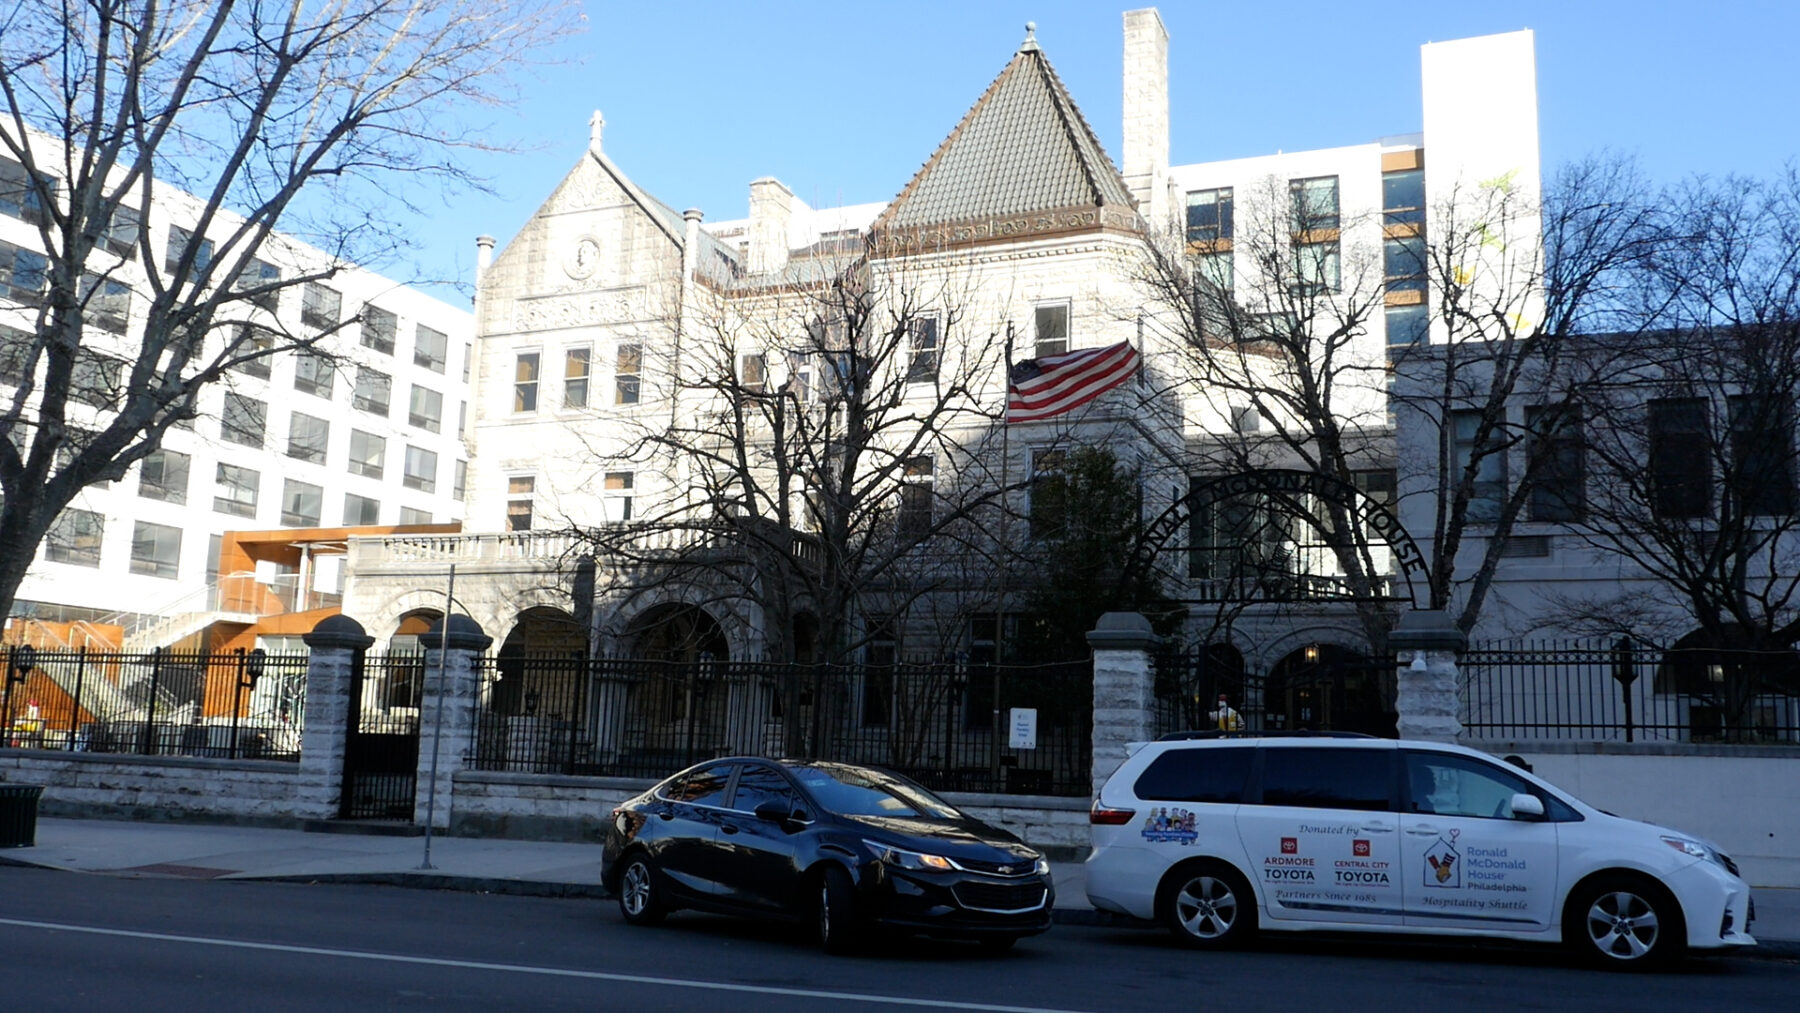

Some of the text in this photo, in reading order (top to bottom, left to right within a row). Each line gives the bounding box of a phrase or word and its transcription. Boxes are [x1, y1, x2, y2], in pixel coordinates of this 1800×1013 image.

[1356, 497, 1425, 575] HOUSE
[1298, 824, 1360, 838] Donated by
[1467, 846, 1508, 857] Ronald
[1264, 856, 1315, 866] ARDMORE
[1334, 860, 1390, 869] CENTRAL CITY
[1467, 858, 1527, 870] McDonald
[1264, 868, 1315, 880] TOYOTA
[1335, 871, 1390, 883] TOYOTA
[1467, 871, 1505, 880] House
[1467, 882, 1528, 893] Philadelphia
[1274, 889, 1321, 899] Partners
[1324, 889, 1351, 900] Since
[1421, 895, 1529, 910] Hospitality Shuttle
